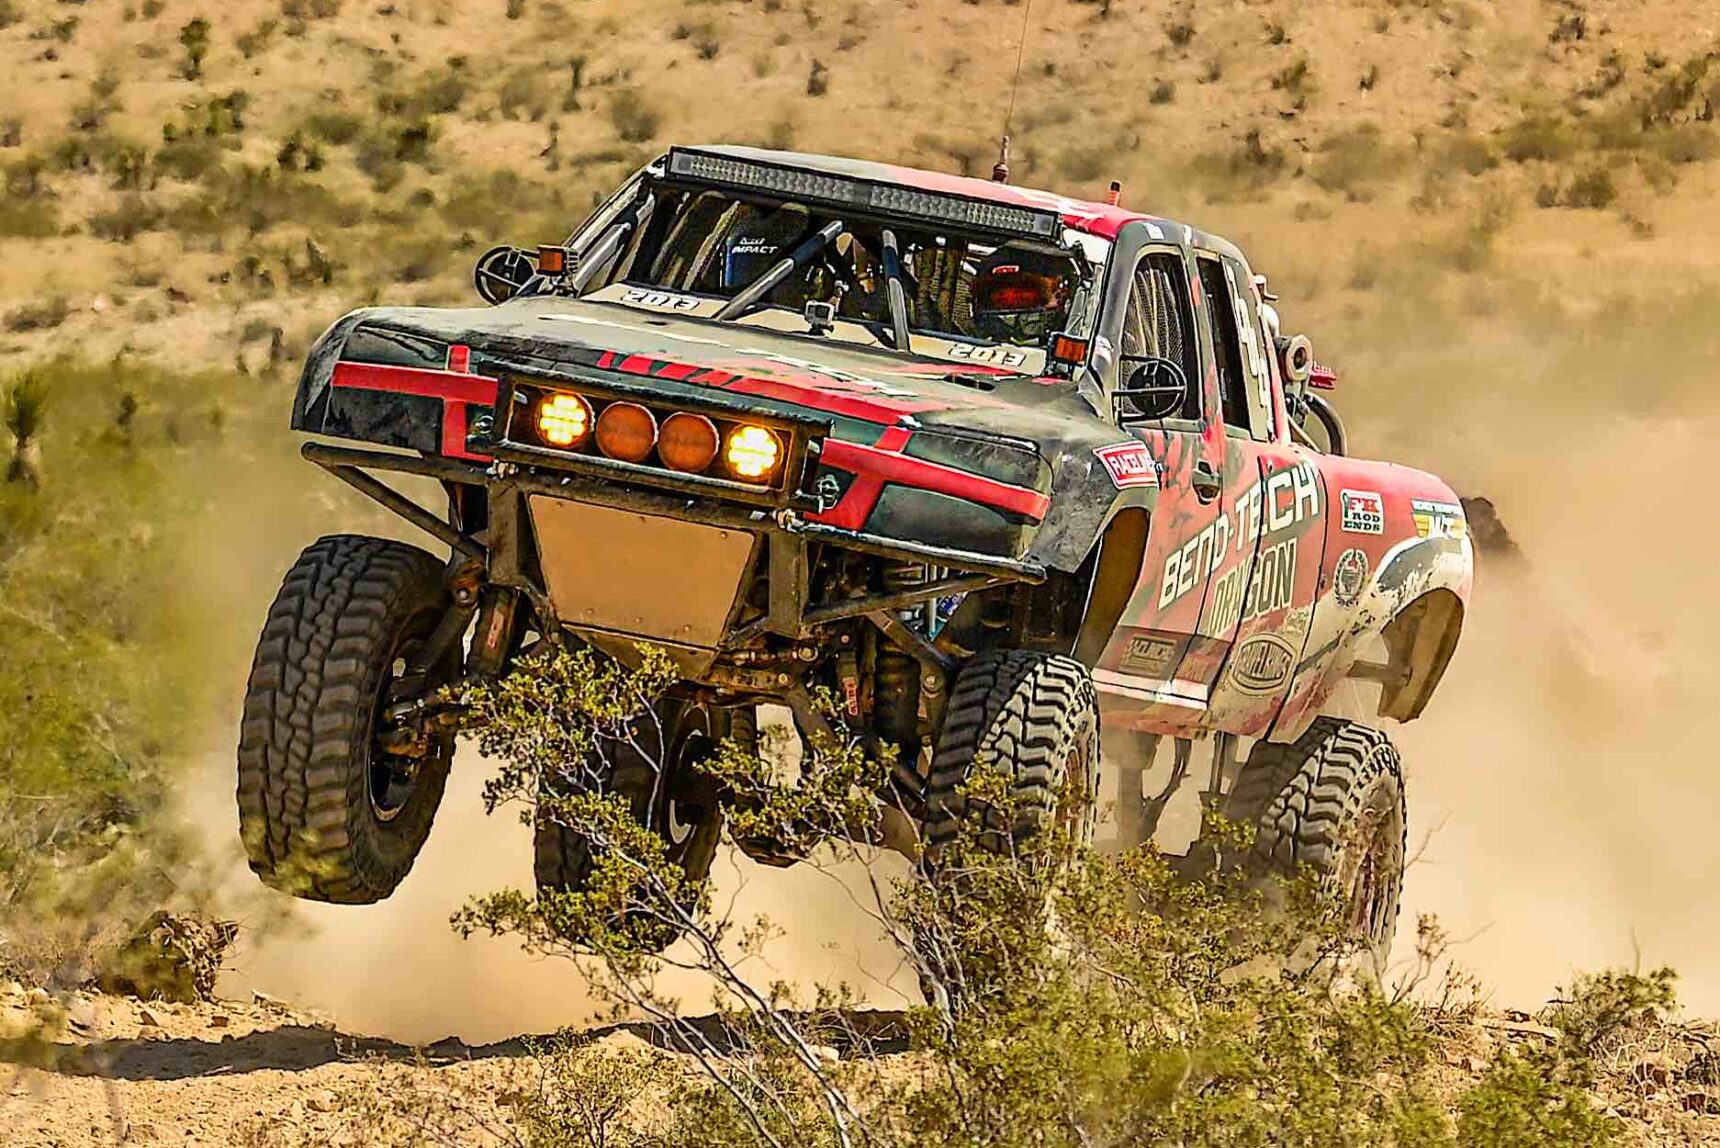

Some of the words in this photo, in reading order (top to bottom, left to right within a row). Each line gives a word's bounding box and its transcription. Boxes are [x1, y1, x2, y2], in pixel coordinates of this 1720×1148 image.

[731, 245, 778, 255] IMPACT
[620, 289, 700, 312] 2013
[947, 343, 1027, 368] 2013
[1349, 497, 1380, 512] FK
[1352, 512, 1381, 523] ROD
[1343, 521, 1381, 531] ENDS
